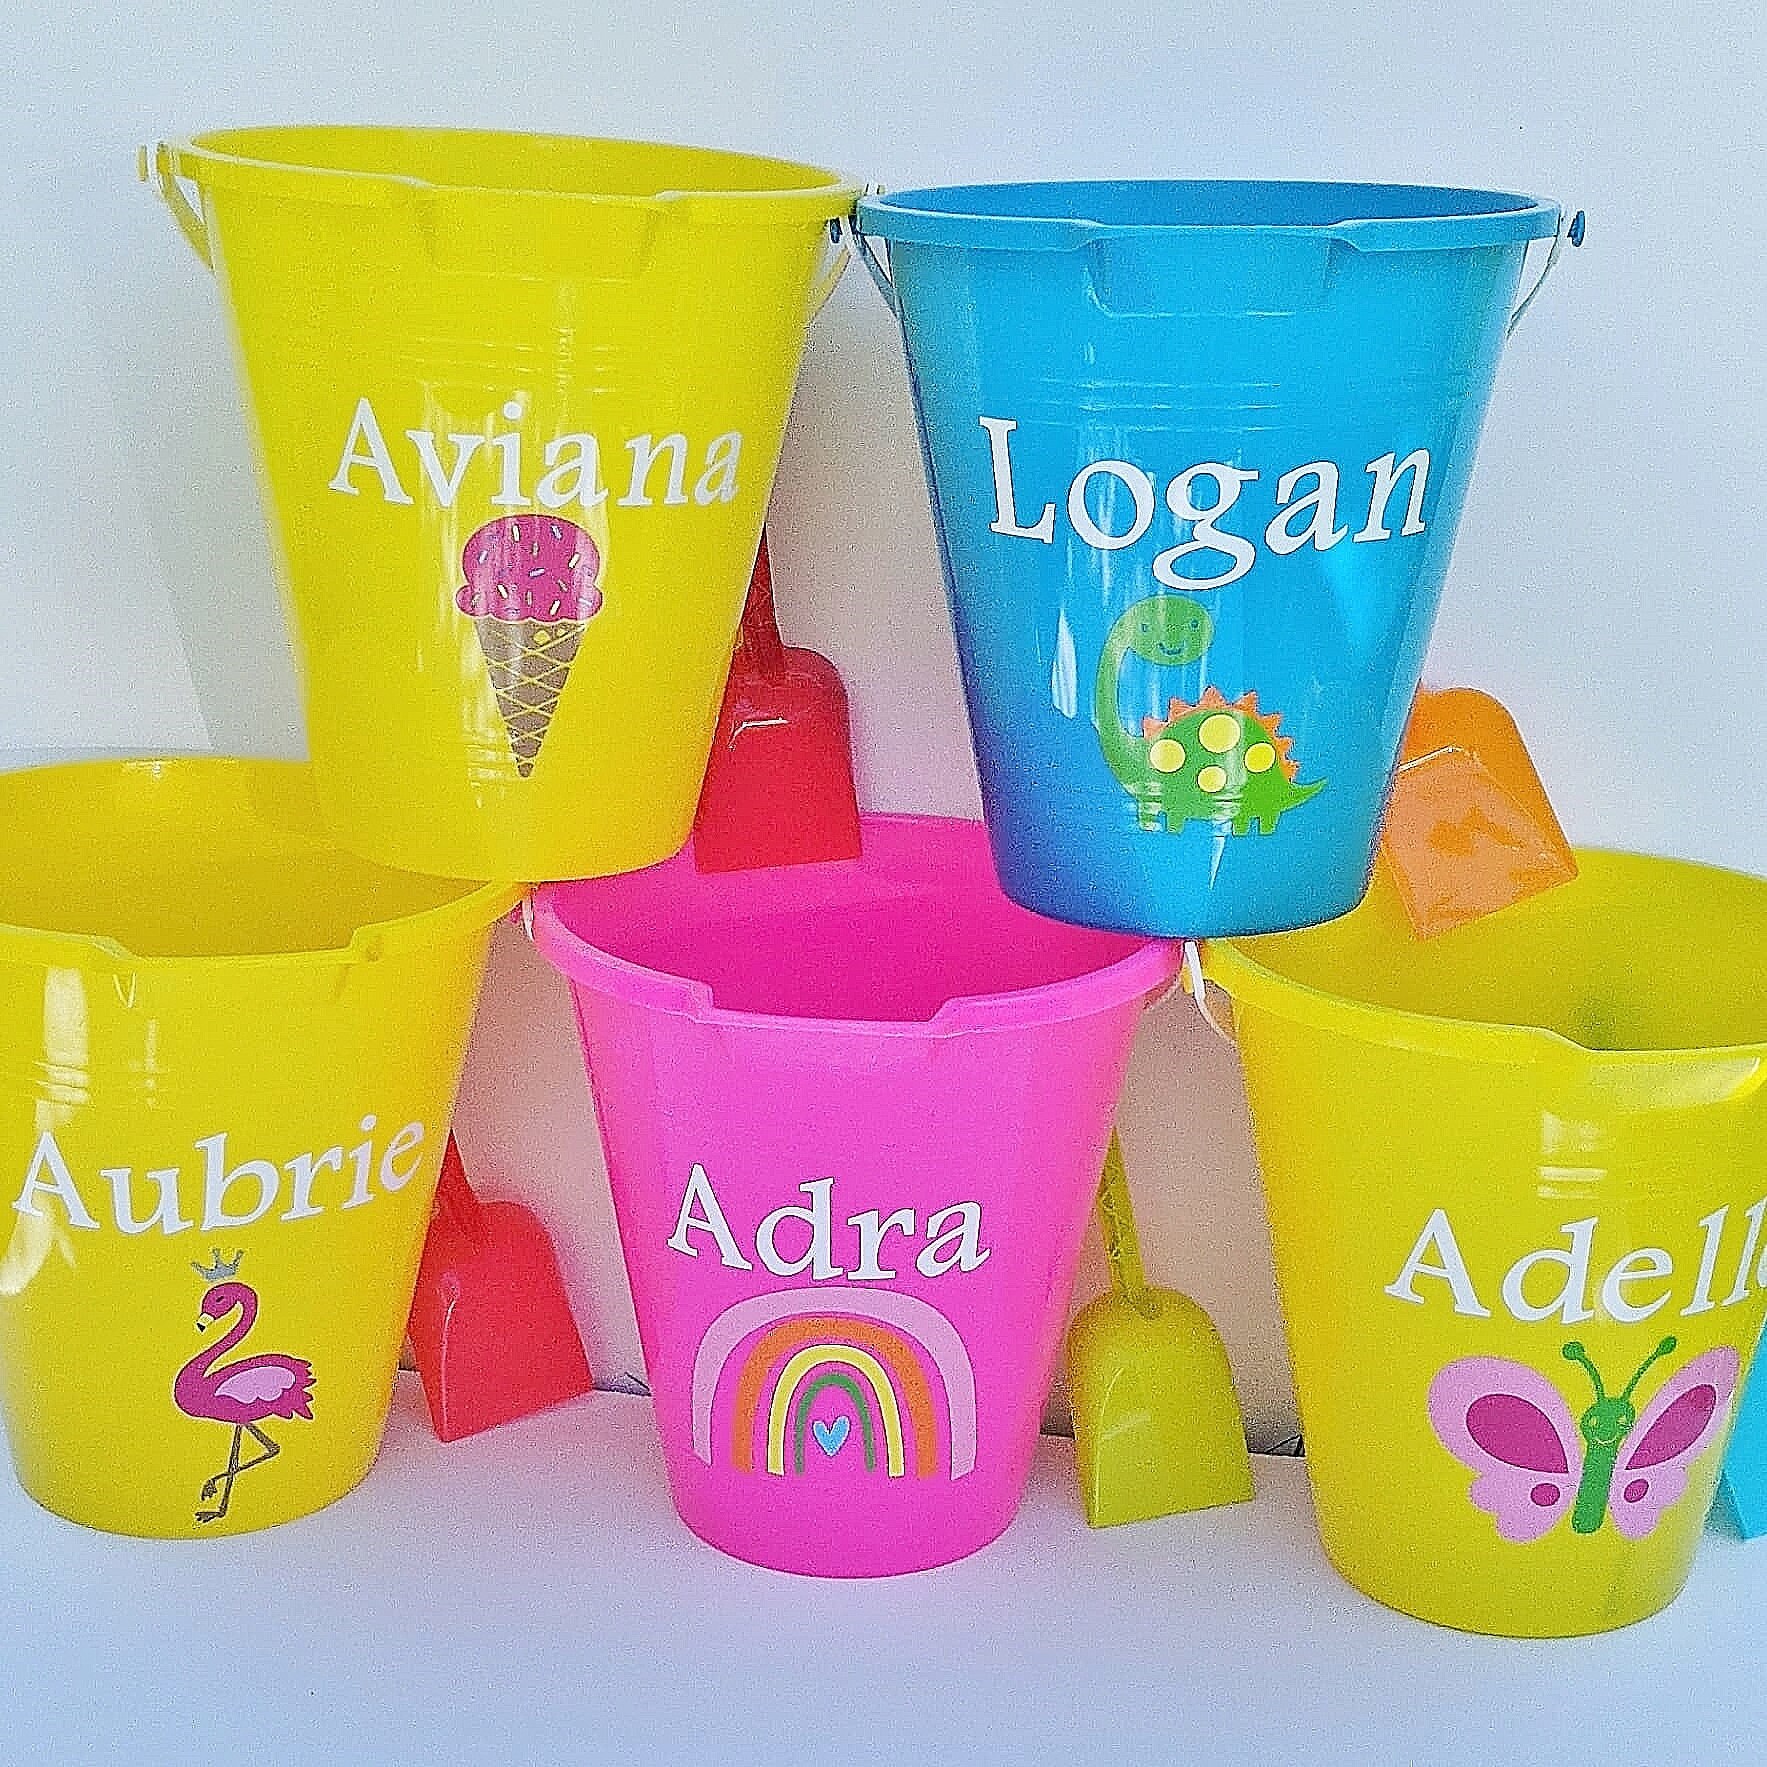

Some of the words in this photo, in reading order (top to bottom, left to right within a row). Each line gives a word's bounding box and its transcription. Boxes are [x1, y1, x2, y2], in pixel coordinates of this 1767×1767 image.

[328, 397, 743, 508] Aviana
[979, 415, 1432, 591] Logan
[12, 1113, 426, 1237] Aubrie
[667, 1162, 991, 1282] Adra
